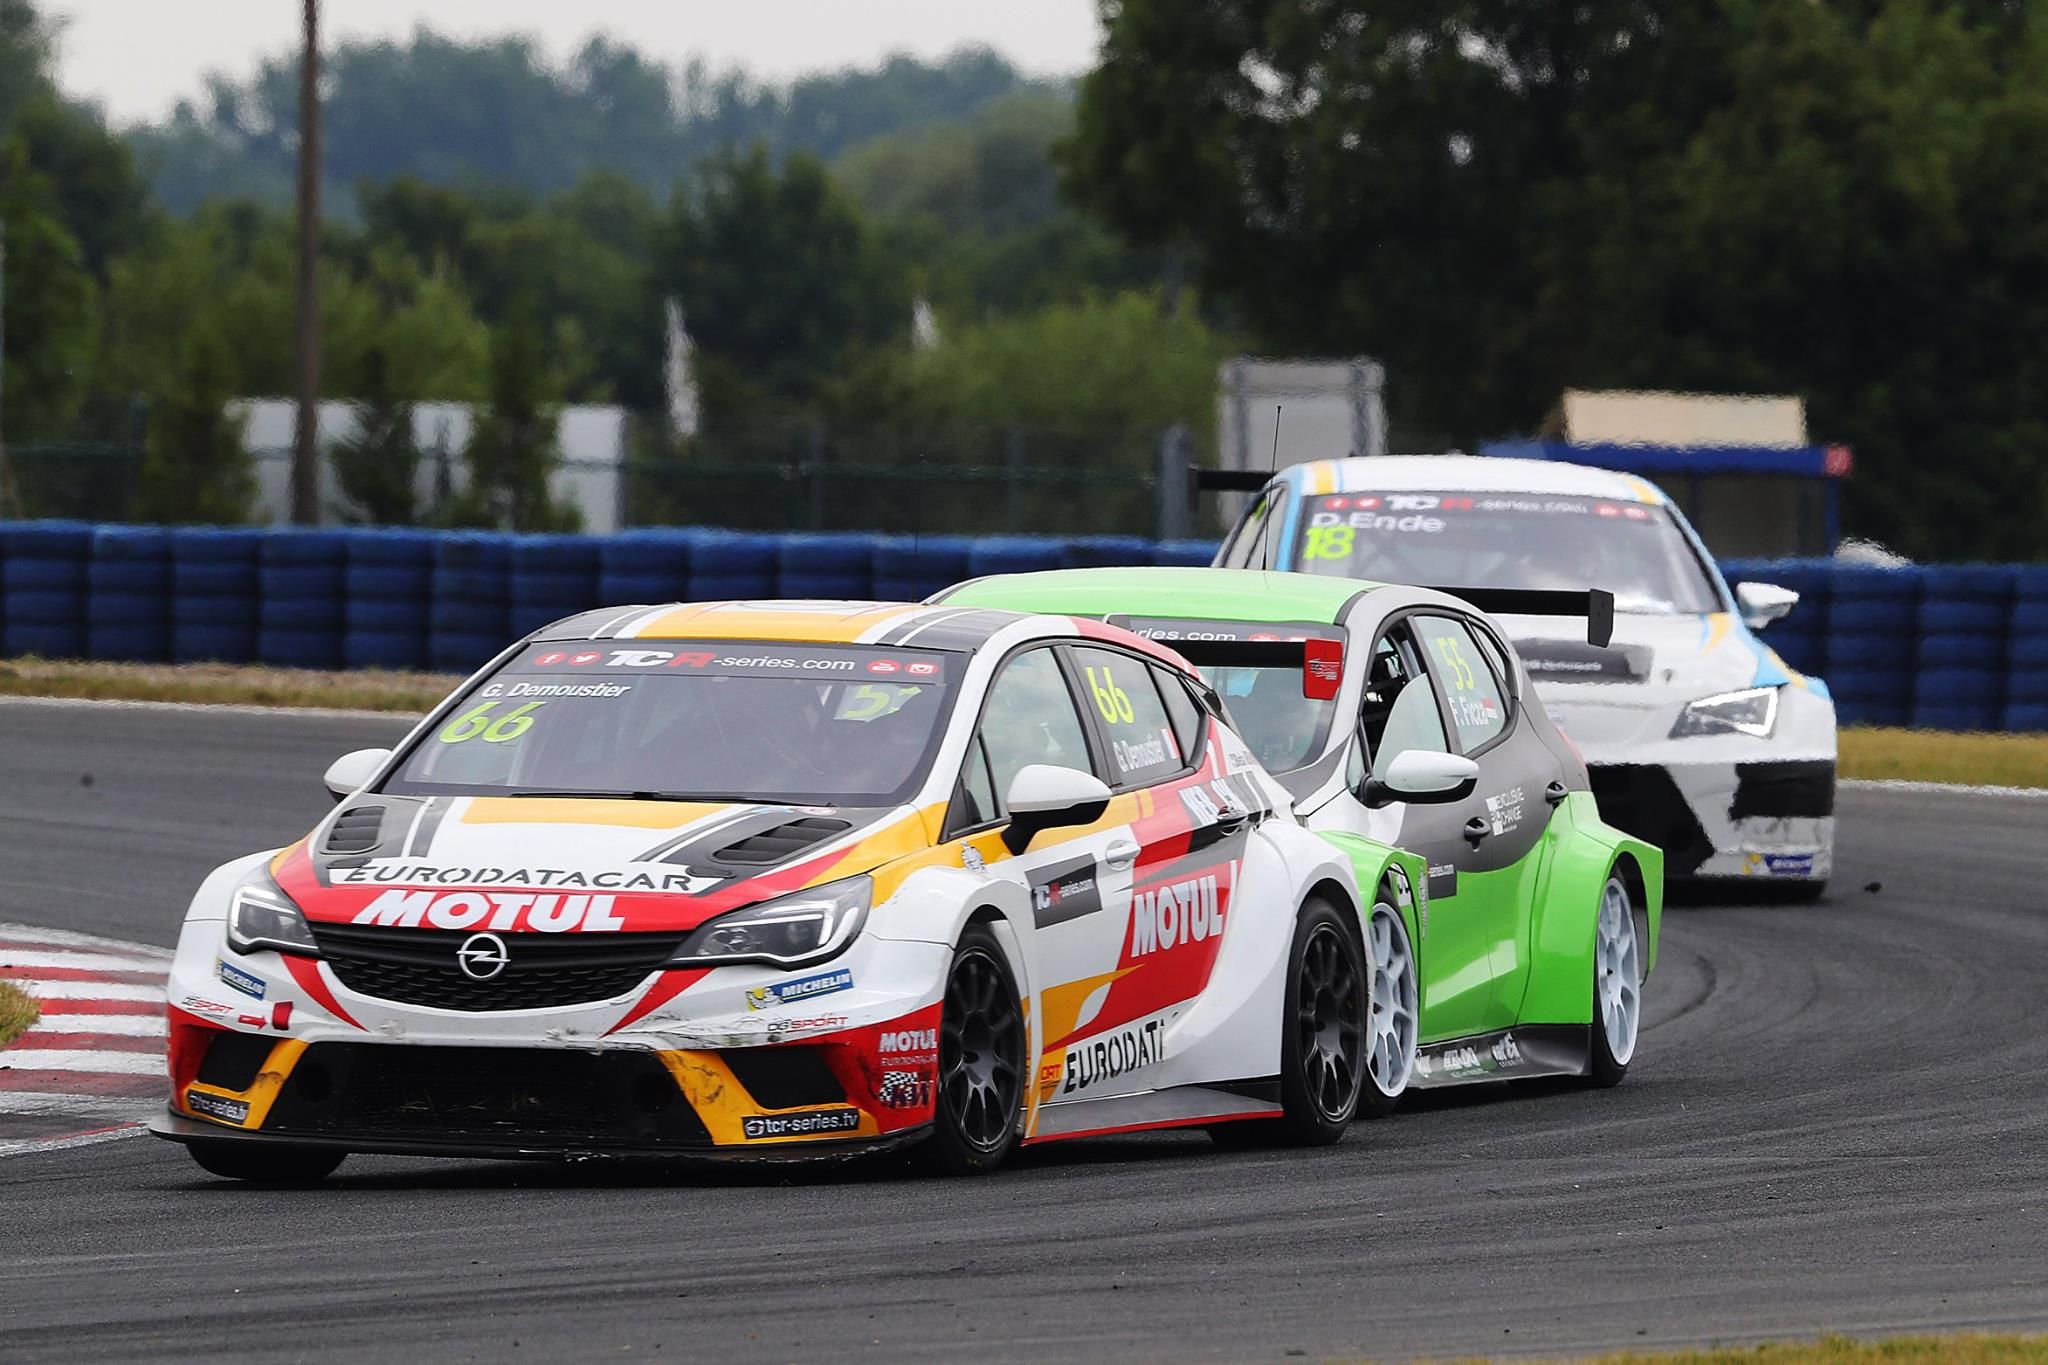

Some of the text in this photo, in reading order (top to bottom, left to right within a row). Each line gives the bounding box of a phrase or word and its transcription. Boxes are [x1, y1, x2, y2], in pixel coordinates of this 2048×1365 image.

[1303, 526, 1355, 560] 18
[1436, 637, 1475, 691] 55
[481, 682, 631, 698] G. Demoustier
[1086, 667, 1135, 725] 66
[439, 701, 549, 744] 66
[344, 865, 693, 892] EURODATACAR
[351, 889, 626, 933] MOTUL
[1131, 875, 1223, 958] MOTUL
[782, 973, 851, 998] MICHELIN
[879, 1028, 938, 1053] MOTUL
[766, 1113, 858, 1133] tcr-series.tv
